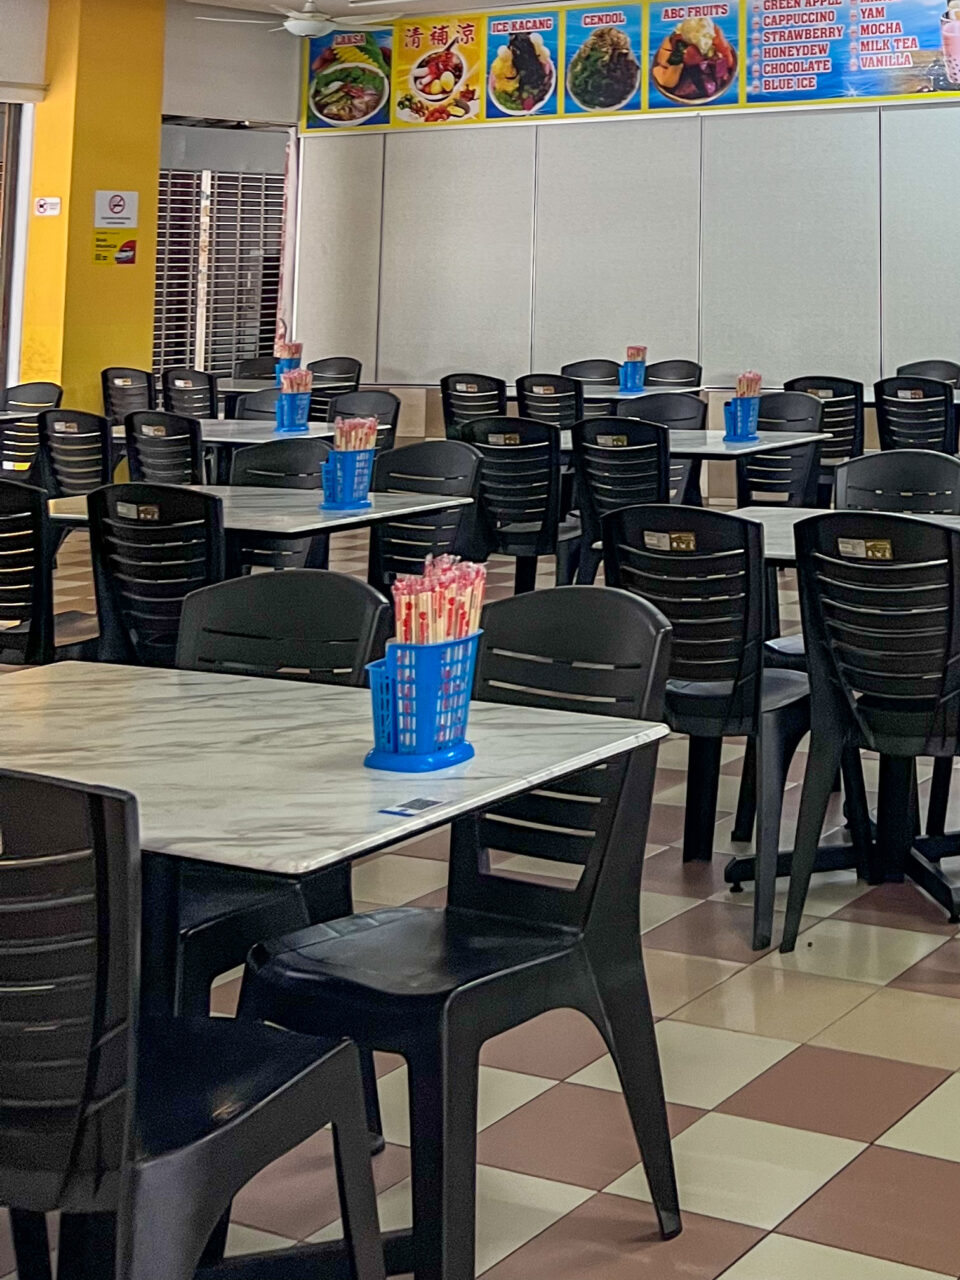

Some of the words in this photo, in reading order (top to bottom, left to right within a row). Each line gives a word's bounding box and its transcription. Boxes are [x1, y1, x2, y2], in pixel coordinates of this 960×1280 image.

[583, 13, 625, 26] CENDOL
[663, 8, 685, 20] ABC
[687, 4, 728, 17] FRUITS
[763, 10, 835, 27] CAPPUCCINO
[860, 7, 885, 20] YAM
[492, 22, 508, 33] ICE
[511, 18, 552, 32] KACANG
[860, 22, 902, 36] MOCHA
[334, 33, 366, 46] LAKSA
[404, 23, 475, 49] 清補涼
[763, 26, 843, 43] STRAWBERRY
[763, 43, 829, 59] HONEYDEW
[860, 39, 890, 52] MILK
[894, 37, 918, 50] TEA
[763, 60, 831, 75] CHOCOLATE
[860, 54, 911, 68] VANILLA
[763, 78, 794, 91] BLUE
[797, 76, 816, 89] ICE
